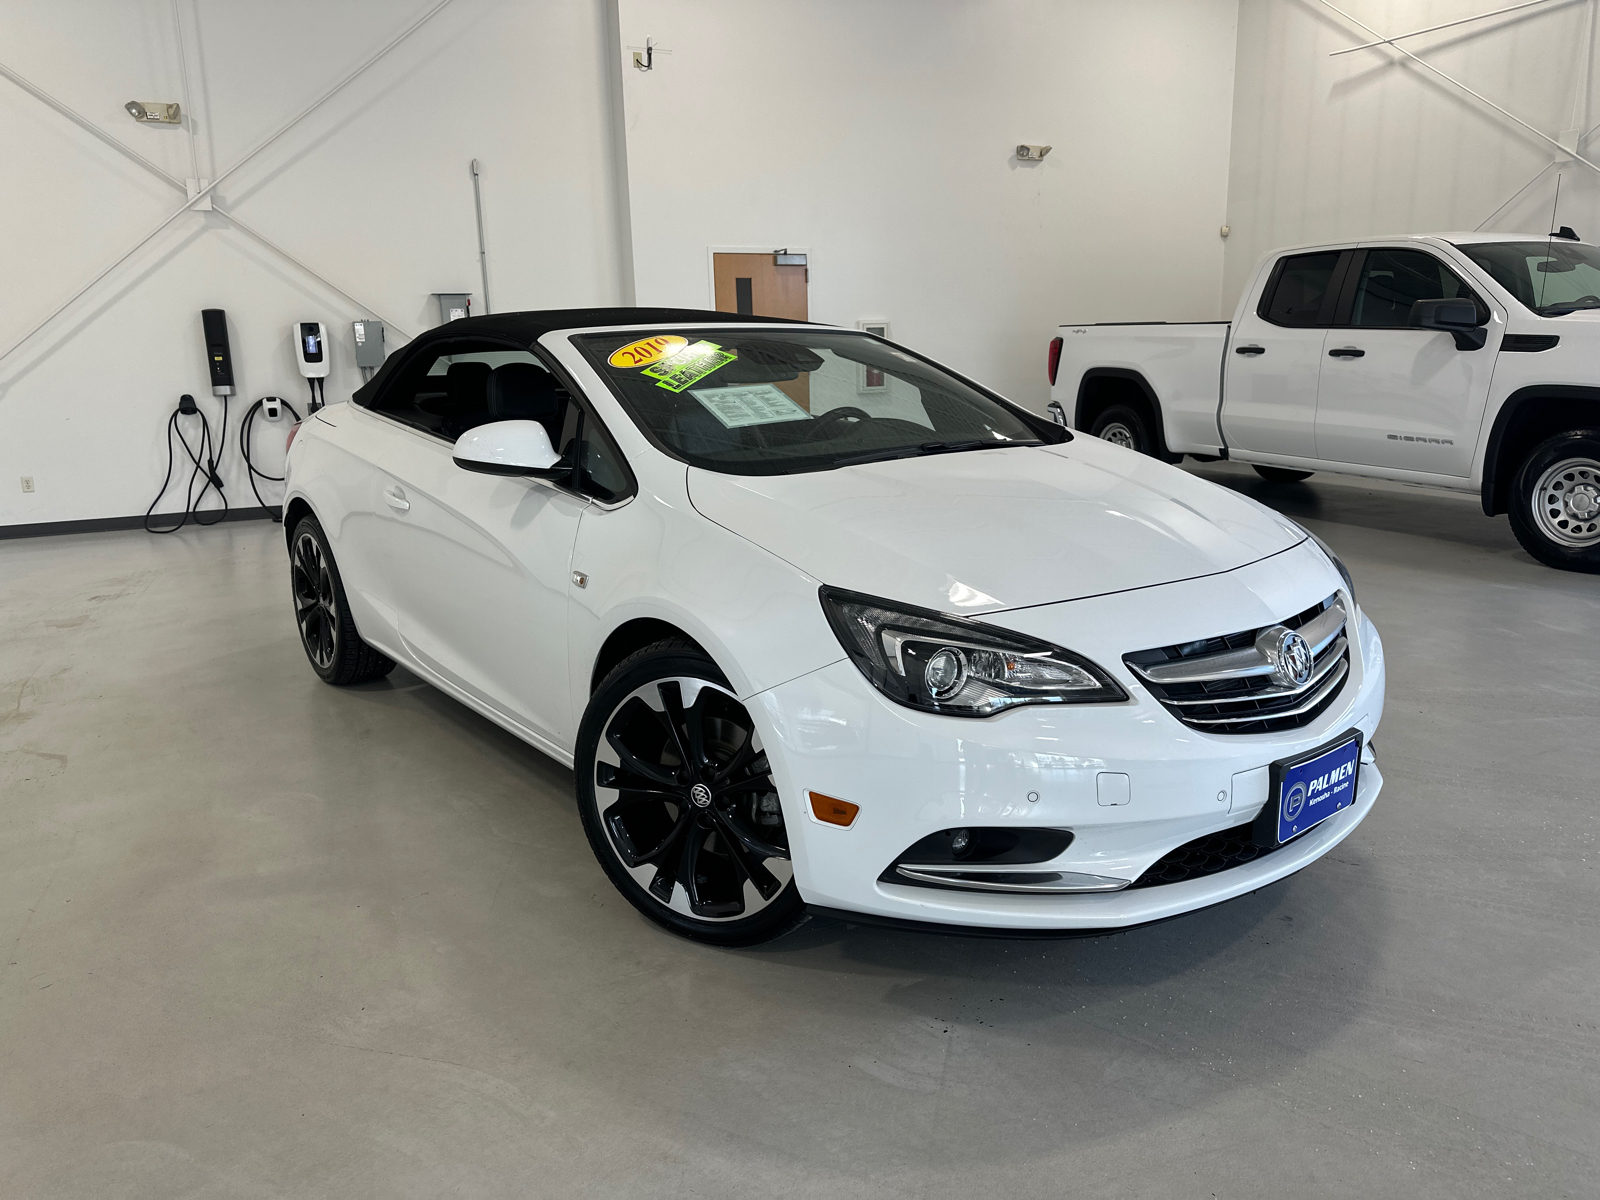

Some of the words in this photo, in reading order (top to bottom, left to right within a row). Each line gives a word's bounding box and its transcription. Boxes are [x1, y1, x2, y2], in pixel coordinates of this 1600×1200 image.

[661, 351, 732, 390] LEATHER
[1387, 434, 1454, 445] SIERRA
[1307, 759, 1355, 796] PALMEN
[1309, 791, 1330, 806] Kenosha
[1333, 781, 1349, 794] Racine
